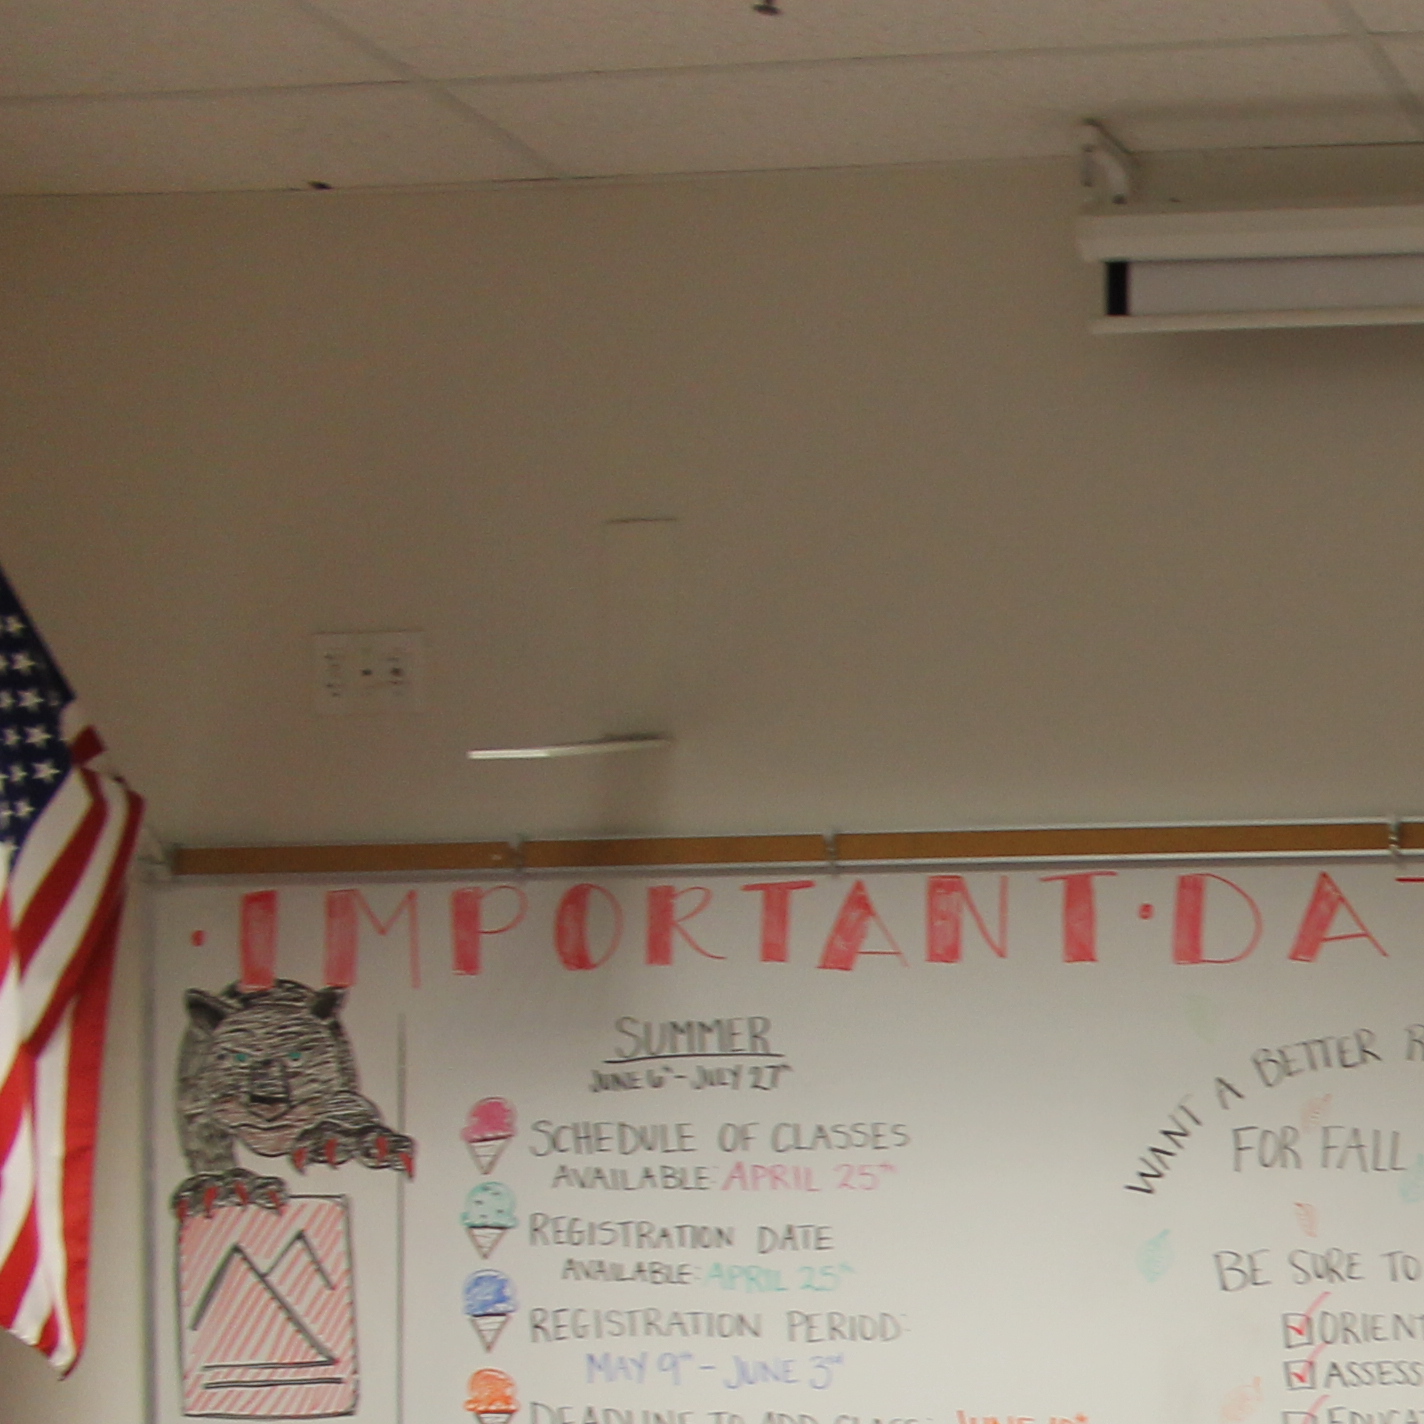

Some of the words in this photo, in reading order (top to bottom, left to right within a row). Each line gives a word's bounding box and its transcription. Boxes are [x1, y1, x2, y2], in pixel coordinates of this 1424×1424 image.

[614, 1016, 773, 1058] SUMMER
[589, 1069, 644, 1093] JUNE
[690, 1064, 744, 1090] JULY
[1124, 1093, 1202, 1194] WANT
[1215, 1076, 1245, 1110] A
[1252, 1028, 1382, 1087] BETTER
[529, 1119, 698, 1157] SCHEDULE
[717, 1122, 760, 1153] OF
[771, 1121, 911, 1153] CLASSES
[1232, 1125, 1302, 1172] FOR
[1321, 1125, 1408, 1173] FALL
[721, 1161, 821, 1192] APRIL
[528, 1212, 736, 1250] REGISTRATION
[757, 1223, 835, 1254] DATE
[704, 1262, 790, 1292] APRIL
[1213, 1249, 1272, 1292] BE
[1289, 1247, 1366, 1285] SURE
[1380, 1251, 1421, 1284] TO
[529, 1307, 763, 1343] REGISTRATION
[585, 1351, 647, 1384] MAY
[723, 1354, 800, 1389] JUNE
